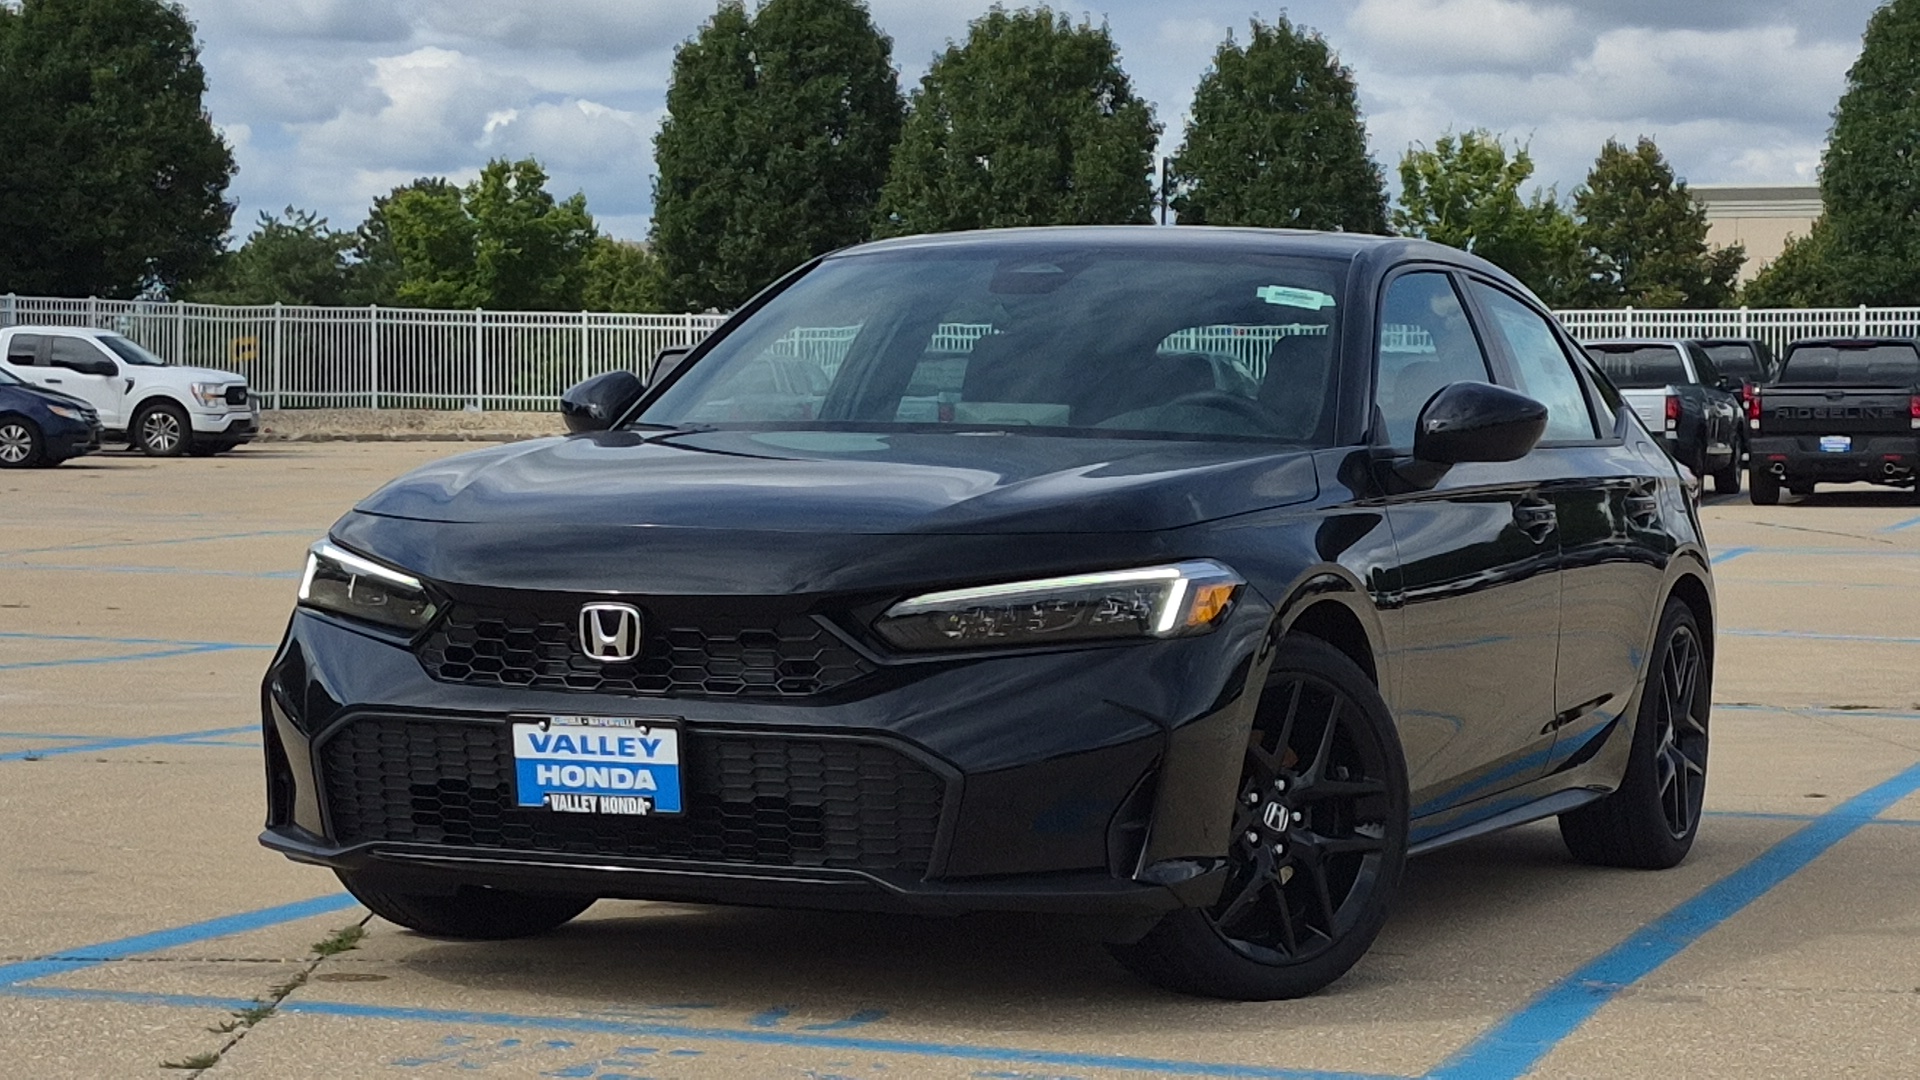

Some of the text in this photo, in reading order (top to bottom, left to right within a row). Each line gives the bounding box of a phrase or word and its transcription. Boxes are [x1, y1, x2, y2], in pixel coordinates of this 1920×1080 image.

[1774, 407, 1894, 419] RIDGELINE
[527, 733, 662, 758] VALLEY
[536, 764, 658, 791] HONDA
[550, 794, 647, 816] VALLEY HONDA
